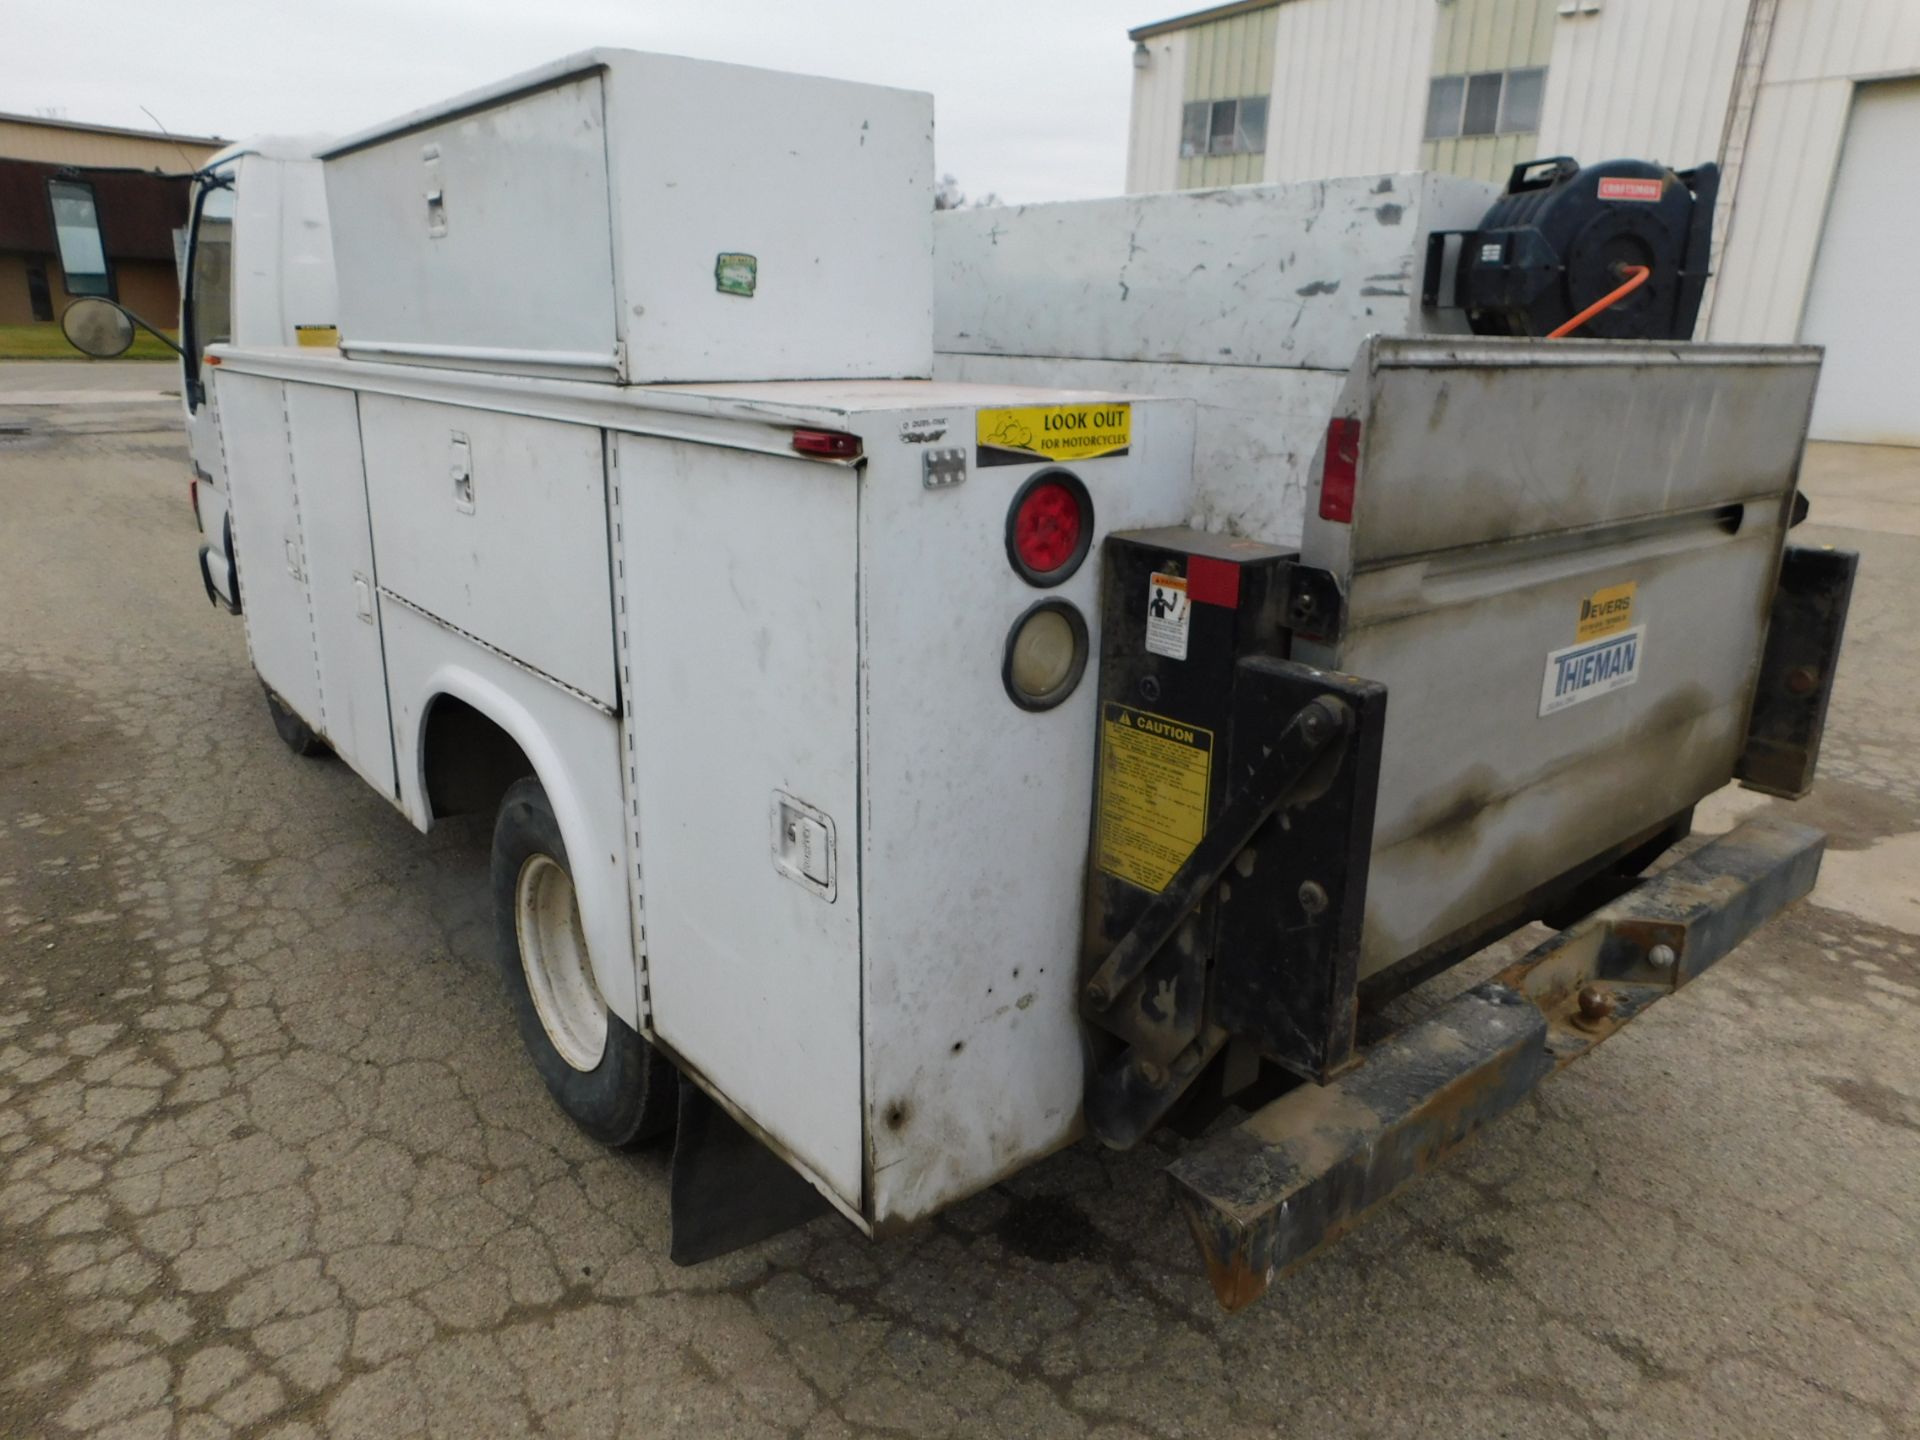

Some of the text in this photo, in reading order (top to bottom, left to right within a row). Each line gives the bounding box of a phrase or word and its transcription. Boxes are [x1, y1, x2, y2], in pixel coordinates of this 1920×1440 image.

[1601, 183, 1658, 197] CRAFTSMAN
[1044, 410, 1125, 431] LOOK OUT
[1041, 434, 1127, 450] FOR MOTORCYCLES
[1580, 597, 1631, 621] DEVERS
[1554, 633, 1638, 697] THIEMAN
[1136, 716, 1194, 744] CAUTION
